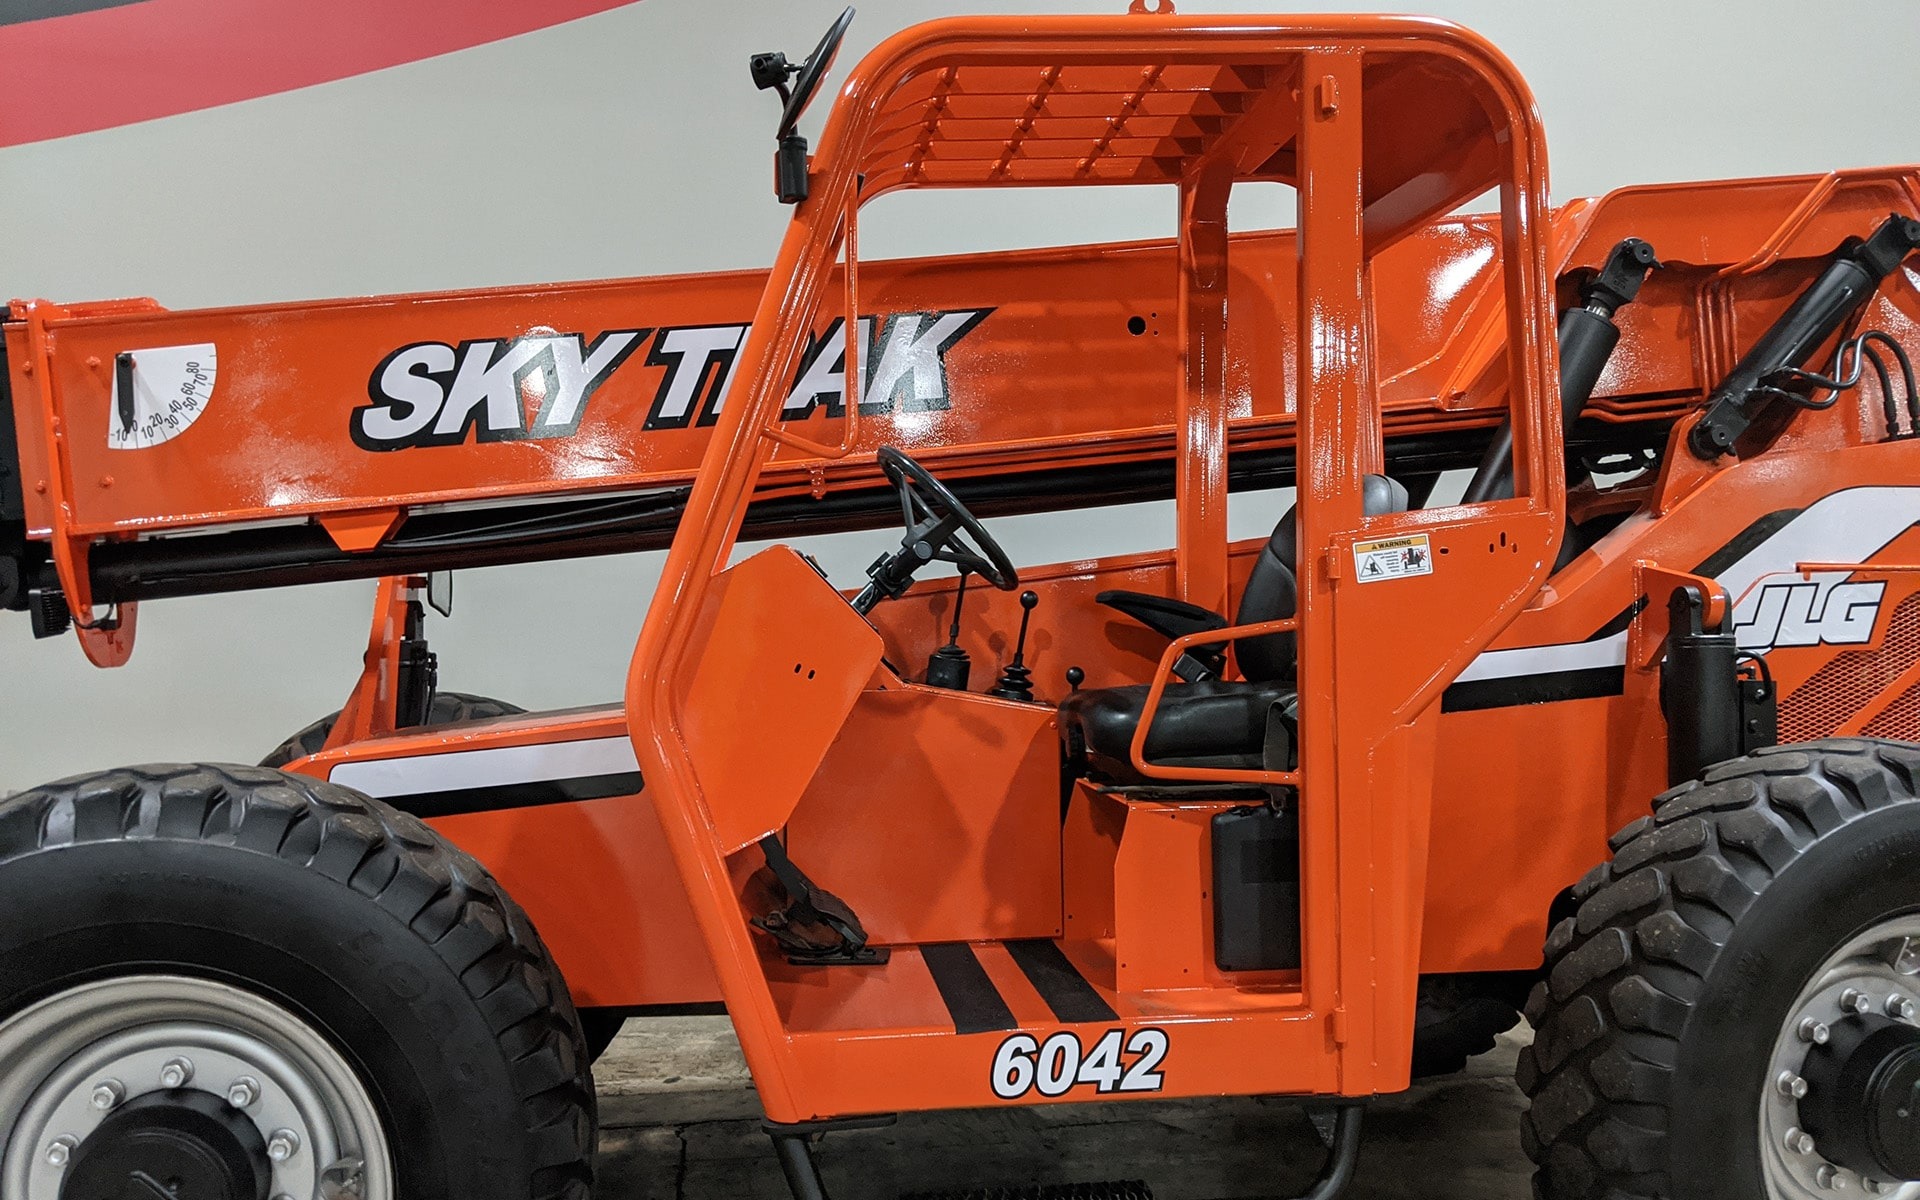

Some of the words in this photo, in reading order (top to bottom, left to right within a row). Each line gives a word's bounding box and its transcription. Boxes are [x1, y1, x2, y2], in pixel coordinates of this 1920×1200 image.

[186, 361, 200, 374] 80
[193, 373, 208, 386] 70
[351, 328, 650, 451] SKY
[643, 307, 996, 430] TAK
[181, 382, 196, 396] 60
[168, 400, 183, 414] 40
[182, 397, 198, 411] 50
[149, 413, 163, 428] 20
[164, 414, 179, 429] 30
[141, 425, 154, 439] 10
[1377, 539, 1412, 550] WARNING
[1733, 580, 1888, 649] JLG
[990, 1027, 1169, 1099] 6042
